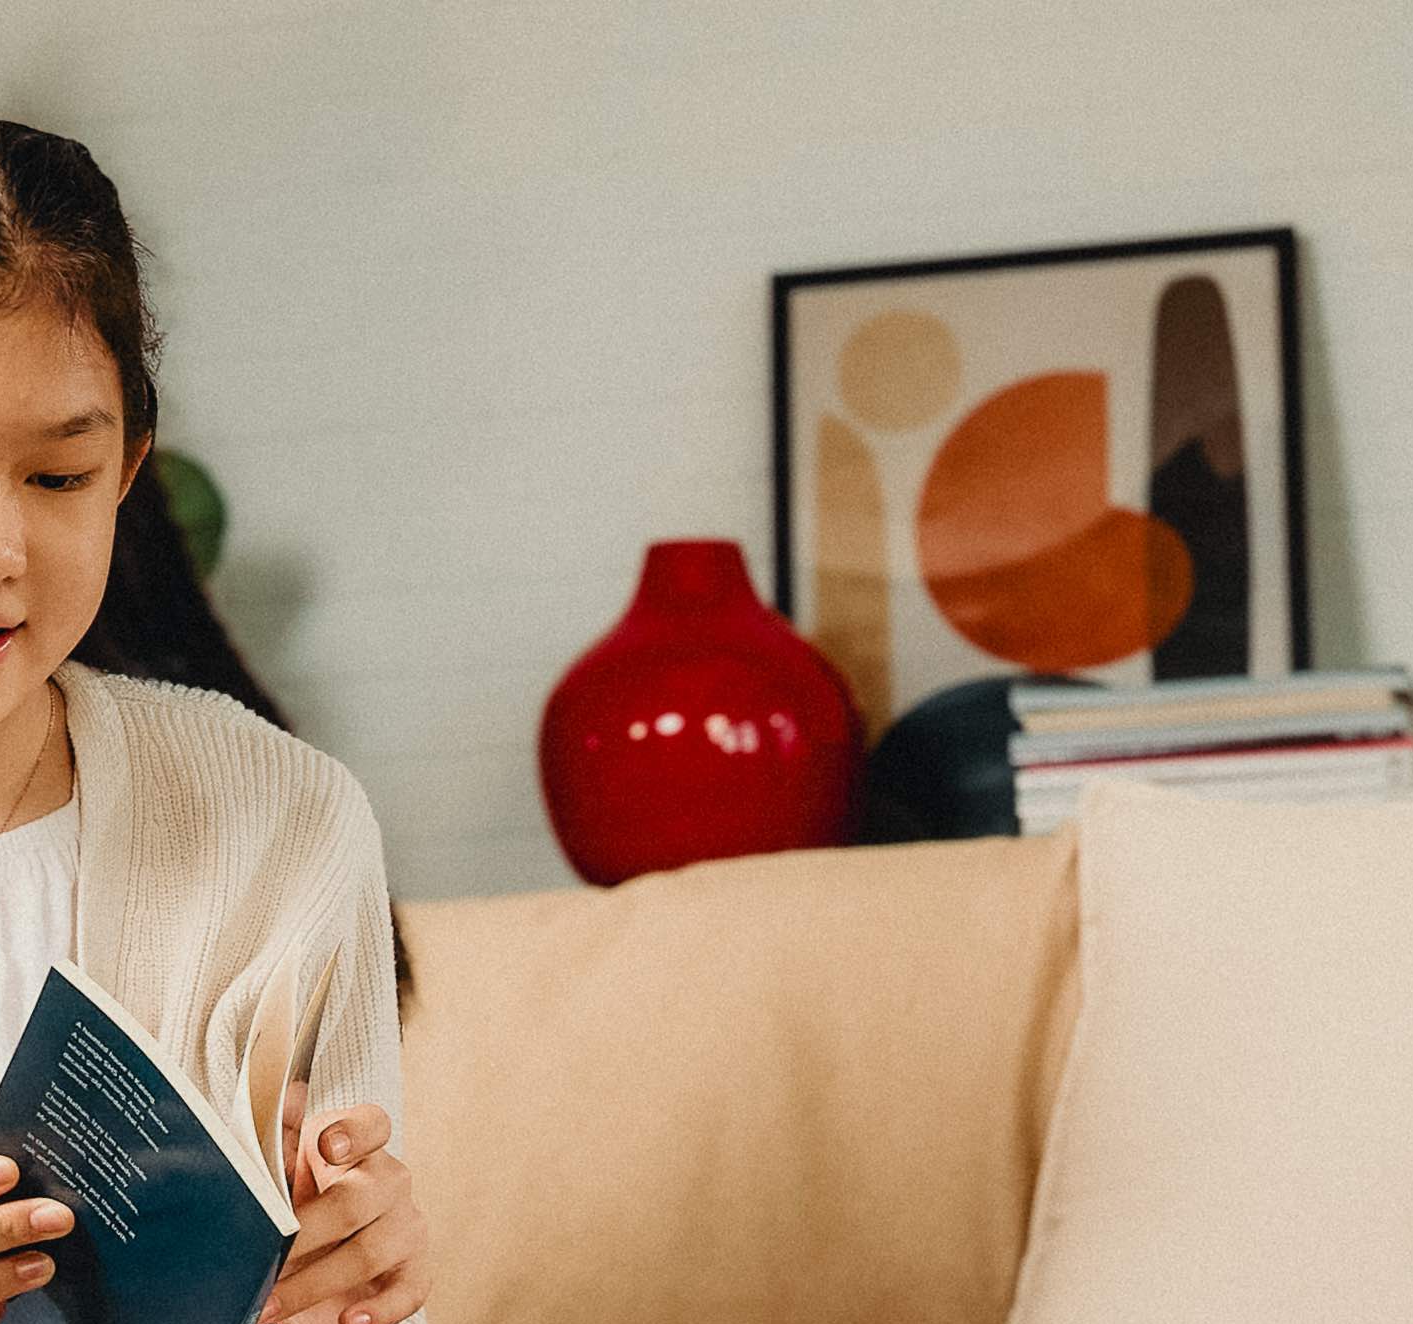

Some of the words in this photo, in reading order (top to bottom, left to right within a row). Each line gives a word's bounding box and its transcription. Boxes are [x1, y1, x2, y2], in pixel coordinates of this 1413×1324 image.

[67, 1041, 86, 1060] who's
[85, 1059, 103, 1076] gone
[103, 1074, 127, 1101] missing.
[127, 1100, 141, 1116] And
[71, 1031, 78, 1039] A
[78, 1037, 103, 1061] strange
[103, 1059, 118, 1077] SMS
[118, 1075, 133, 1092] from
[133, 1091, 148, 1109] their
[147, 1108, 169, 1134] teacher
[75, 1021, 82, 1029] A
[82, 1026, 108, 1053] haunted
[108, 1051, 128, 1072] house
[127, 1070, 134, 1080] in
[45, 1091, 63, 1109] Chua
[63, 1106, 79, 1122] have
[79, 1121, 87, 1131] to
[87, 1129, 99, 1142] put
[99, 1140, 114, 1157] their
[113, 1155, 131, 1178] heads
[62, 1051, 102, 1089] decades-old
[101, 1087, 124, 1111] murder
[124, 1109, 138, 1126] that
[137, 1125, 160, 1153] remains
[91, 1118, 105, 1134] Izzy
[104, 1131, 117, 1147] Lim
[116, 1145, 129, 1160] and
[22, 1143, 37, 1156] risk
[36, 1153, 51, 1167] and
[49, 1164, 77, 1189] discover
[76, 1187, 83, 1195] a
[26, 1131, 35, 1141] In
[35, 1138, 48, 1150] the
[47, 1148, 74, 1175] process,
[75, 1172, 90, 1188] they
[88, 1187, 101, 1200] put
[101, 1198, 115, 1215] their
[115, 1213, 129, 1231] lives
[127, 1229, 137, 1240] at
[37, 1111, 46, 1122] Mr
[46, 1121, 67, 1140] Adam
[87, 1157, 115, 1187] suddenly
[41, 1102, 70, 1128] together
[70, 1127, 84, 1141] and
[83, 1139, 116, 1174] investigate
[115, 1172, 129, 1188] why
